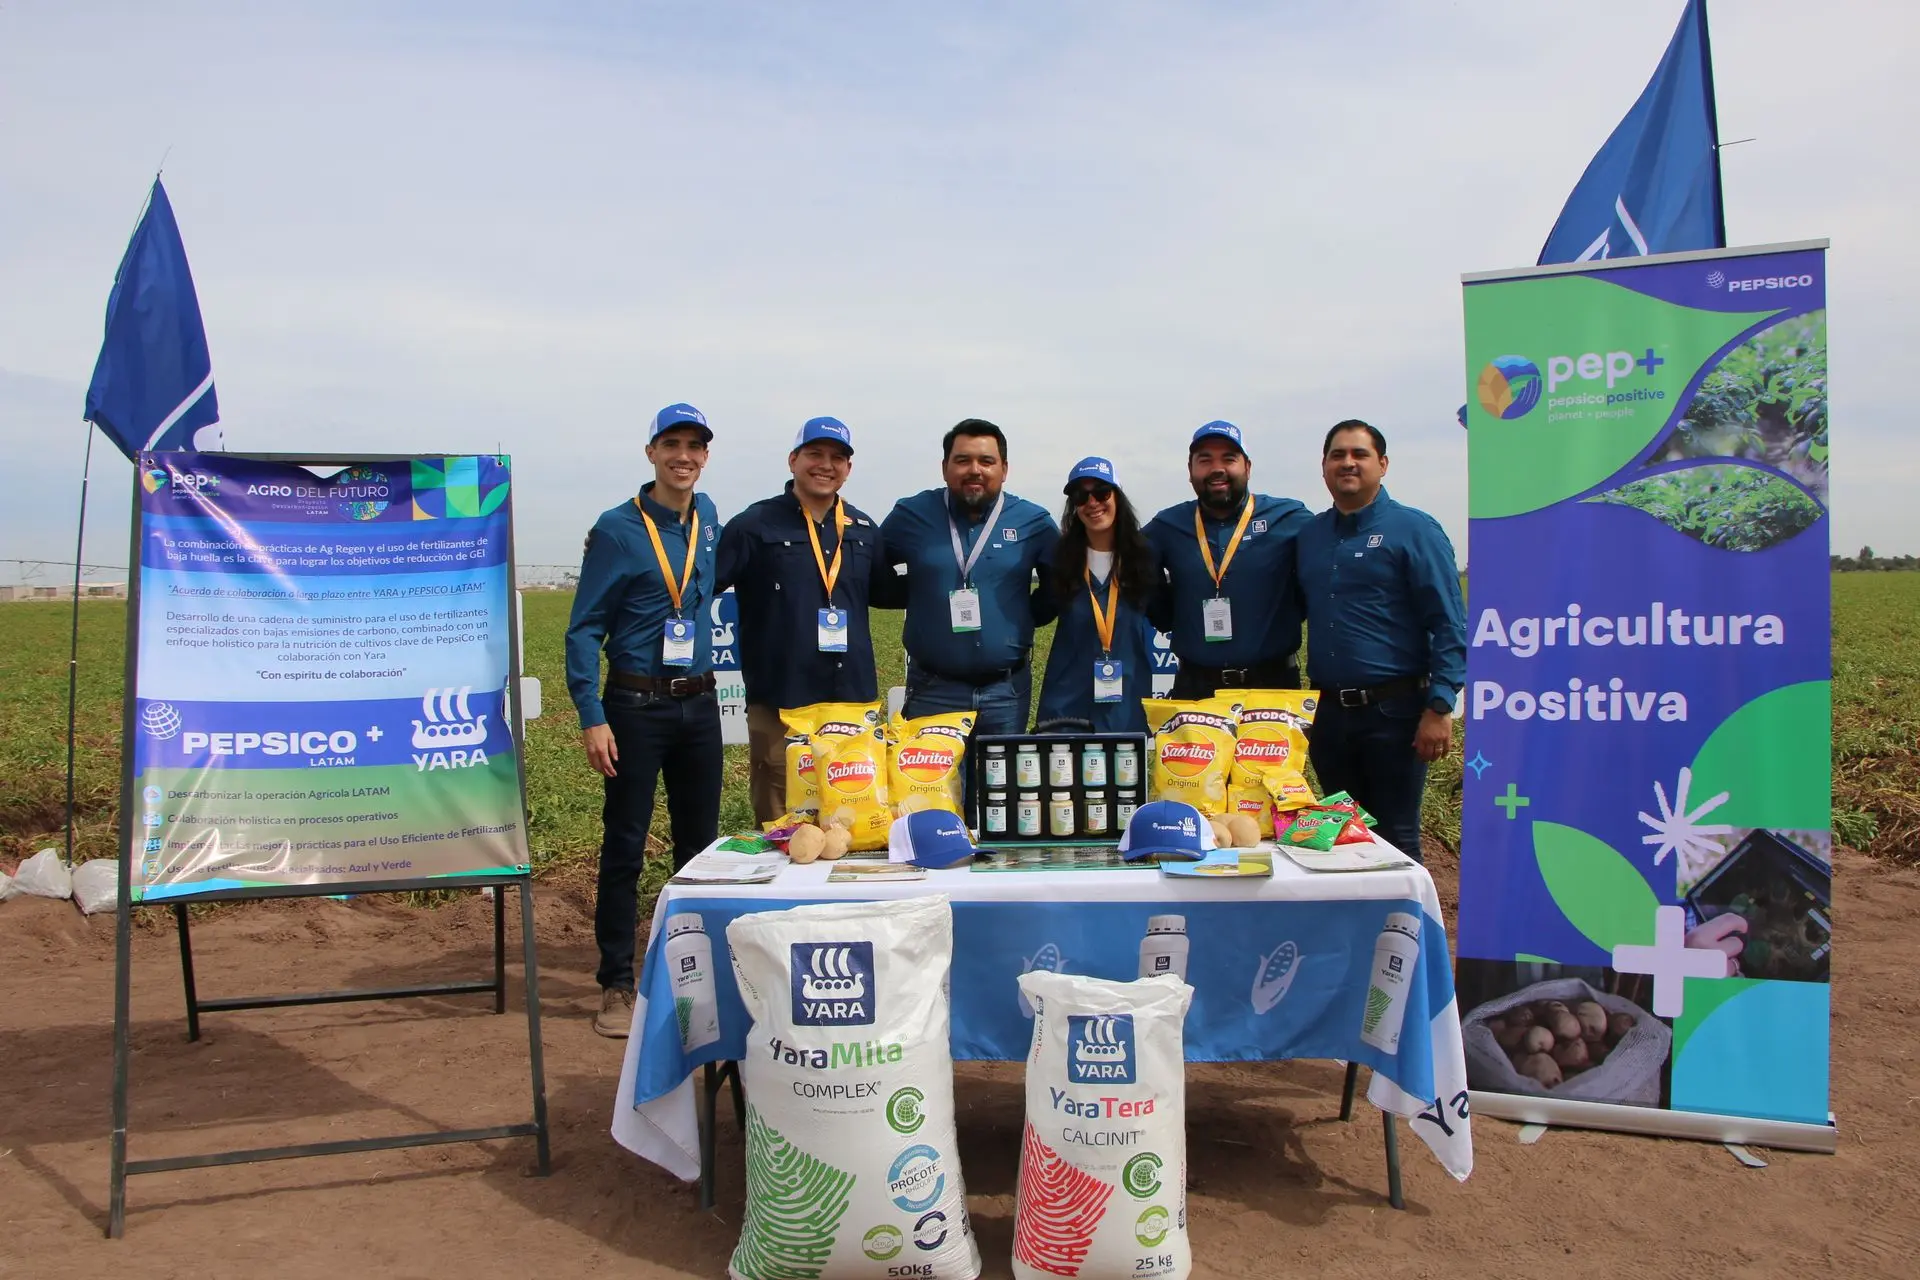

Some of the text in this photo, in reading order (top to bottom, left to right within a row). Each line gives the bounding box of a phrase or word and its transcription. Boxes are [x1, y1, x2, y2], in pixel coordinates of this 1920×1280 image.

[1728, 274, 1813, 292] PEPSICO
[1548, 348, 1665, 393] pep+
[247, 484, 389, 498] AGRO DEL FUTURO
[164, 538, 175, 547] La
[178, 539, 242, 550] combinación
[307, 544, 318, 553] de
[320, 545, 333, 556] Ag
[336, 544, 366, 555] Regen
[368, 546, 374, 554] y
[376, 543, 386, 552] el
[387, 544, 405, 552] uso
[406, 542, 418, 551] de
[420, 539, 476, 550] fertilizantes
[476, 537, 488, 546] de
[167, 552, 188, 563] baja
[190, 553, 221, 563] huella
[236, 554, 246, 563] la
[275, 557, 298, 567] para
[300, 556, 328, 568] lograr
[331, 556, 345, 566] los
[346, 555, 391, 567] objetivos
[392, 554, 405, 564] de
[406, 551, 454, 563] reducción
[455, 551, 468, 561] de
[469, 550, 486, 559] GEI
[213, 586, 225, 596] de
[227, 587, 287, 598] colaboración
[288, 590, 295, 598] a
[321, 590, 345, 602] plazo
[346, 590, 371, 598] entre
[373, 588, 399, 597] YARA
[401, 590, 407, 599] y
[408, 586, 449, 596] PEPSICO
[166, 608, 489, 625] Desarrollo de una cadena de suministro para el uso de fertilizantes
[166, 621, 489, 638] especializados con bajas emisiones de carbono, combinado con un
[1472, 602, 1784, 658] Agricultura
[166, 637, 210, 648] enfoque
[257, 640, 280, 651] para
[281, 640, 291, 649] la
[292, 640, 337, 650] nutrición
[339, 639, 352, 649] de
[354, 638, 392, 648] cultivos
[394, 637, 419, 647] clave
[421, 635, 434, 645] de
[436, 632, 475, 645] PepsiCo
[477, 632, 489, 641] en
[277, 651, 386, 663] colaboración con Yara
[324, 669, 337, 680] de
[1472, 677, 1687, 722] Positiva
[183, 730, 357, 755] PEPSICO
[1160, 743, 1216, 759] Sabritas
[1235, 742, 1290, 757] Sabritas
[309, 756, 356, 767] LATAM
[411, 748, 490, 772] YARA
[898, 749, 954, 766] Sabritas
[827, 761, 876, 781] Sabritas
[909, 783, 943, 793] Original
[1167, 778, 1200, 789] Original
[244, 790, 253, 800] la
[255, 789, 306, 801] operación
[351, 786, 391, 797] LATAM
[840, 795, 871, 805] Original
[283, 816, 296, 825] en
[298, 815, 344, 827] procesos
[346, 811, 399, 823] operativos
[295, 839, 342, 851] prácticas
[343, 838, 366, 850] para
[368, 837, 377, 846] el
[379, 835, 400, 846] Uso
[401, 833, 445, 845] Eficiente
[446, 830, 460, 840] de
[461, 820, 517, 838] Fertilizantes
[348, 859, 412, 873] Azul y Verde
[802, 1001, 866, 1019] YARA
[769, 1036, 904, 1070] YaraMila
[1075, 1063, 1128, 1079] YARA
[1049, 1086, 1155, 1119] YaraTera
[1062, 1127, 1141, 1146] CALCINIT
[890, 1161, 939, 1193] PROCOTE
[888, 1263, 933, 1277] 50kg
[1135, 1254, 1173, 1270] 25 kg
